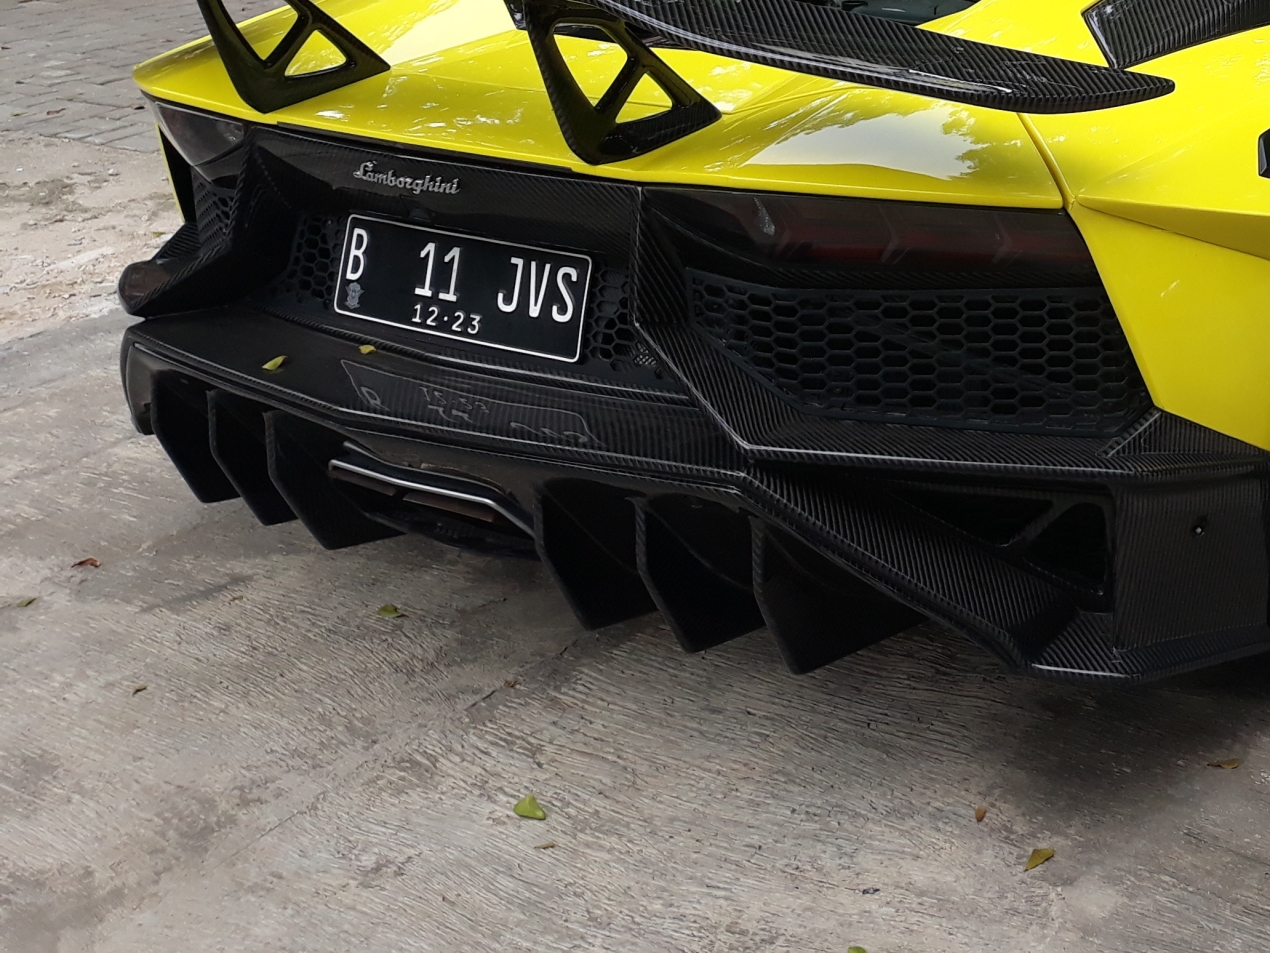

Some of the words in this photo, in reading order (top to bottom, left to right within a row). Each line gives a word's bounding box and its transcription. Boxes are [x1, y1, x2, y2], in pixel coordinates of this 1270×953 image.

[353, 161, 460, 195] Lamborghini
[345, 227, 369, 280] B
[413, 242, 462, 302] 11
[497, 256, 578, 323] JVS
